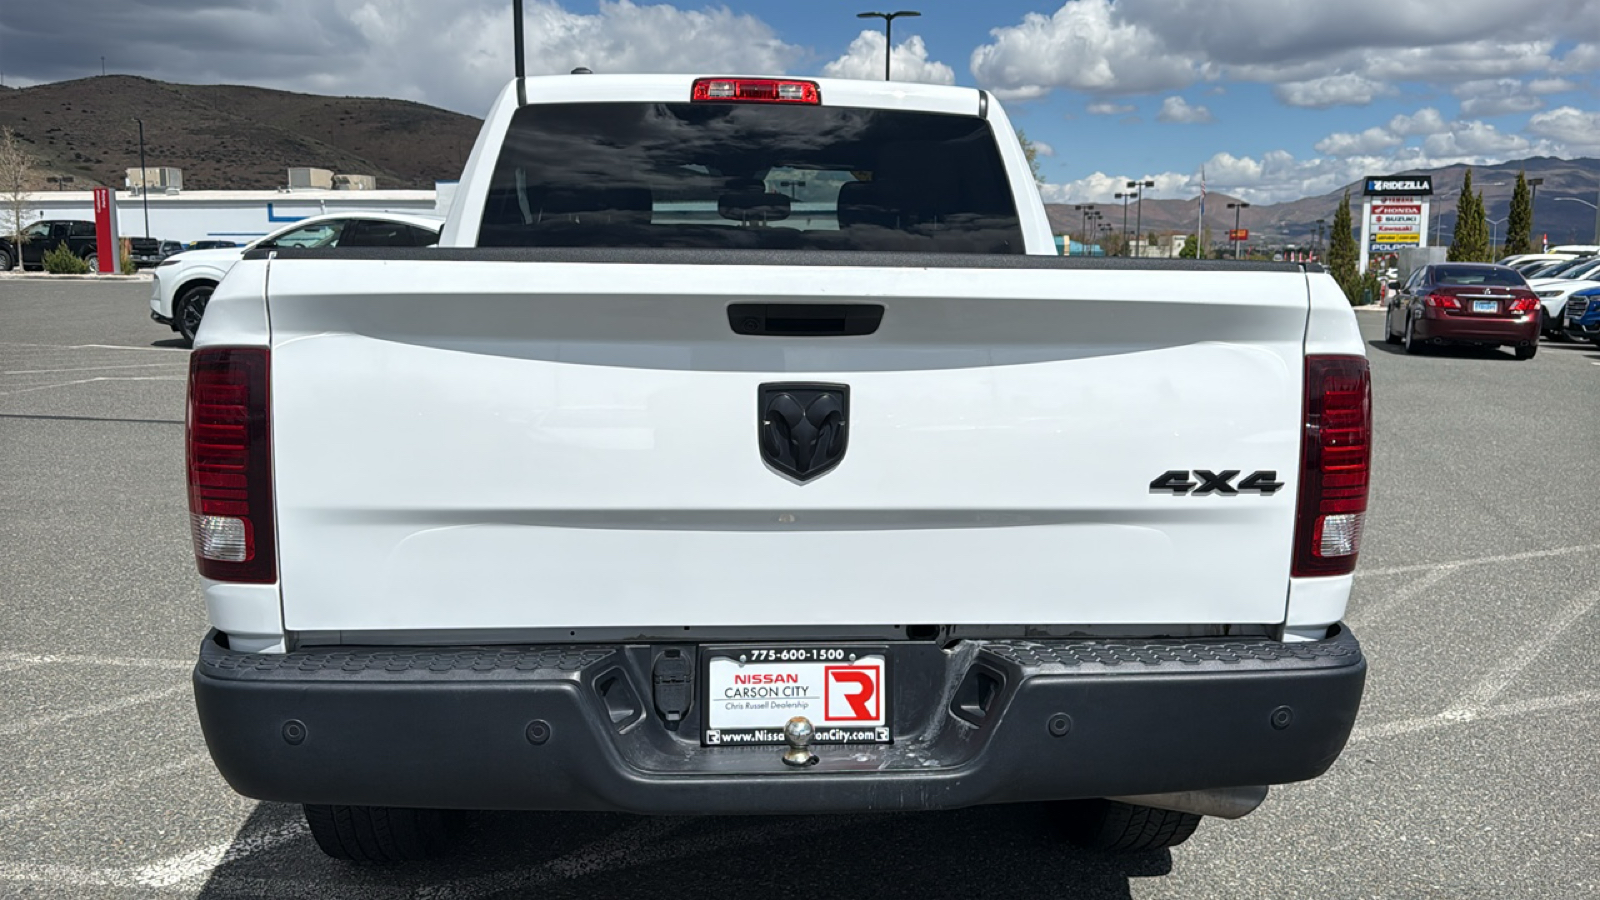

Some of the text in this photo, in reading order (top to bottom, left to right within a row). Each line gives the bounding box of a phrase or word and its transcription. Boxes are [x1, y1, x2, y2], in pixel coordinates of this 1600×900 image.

[1383, 180, 1430, 190] RIDEZILLA
[751, 649, 845, 660] 775-600-1500
[735, 673, 799, 685] NISSAN
[724, 685, 810, 698] CARSON CITY
[725, 700, 809, 710] Chris Russell Dealership
[721, 729, 875, 743] www.NissaonCity.com
